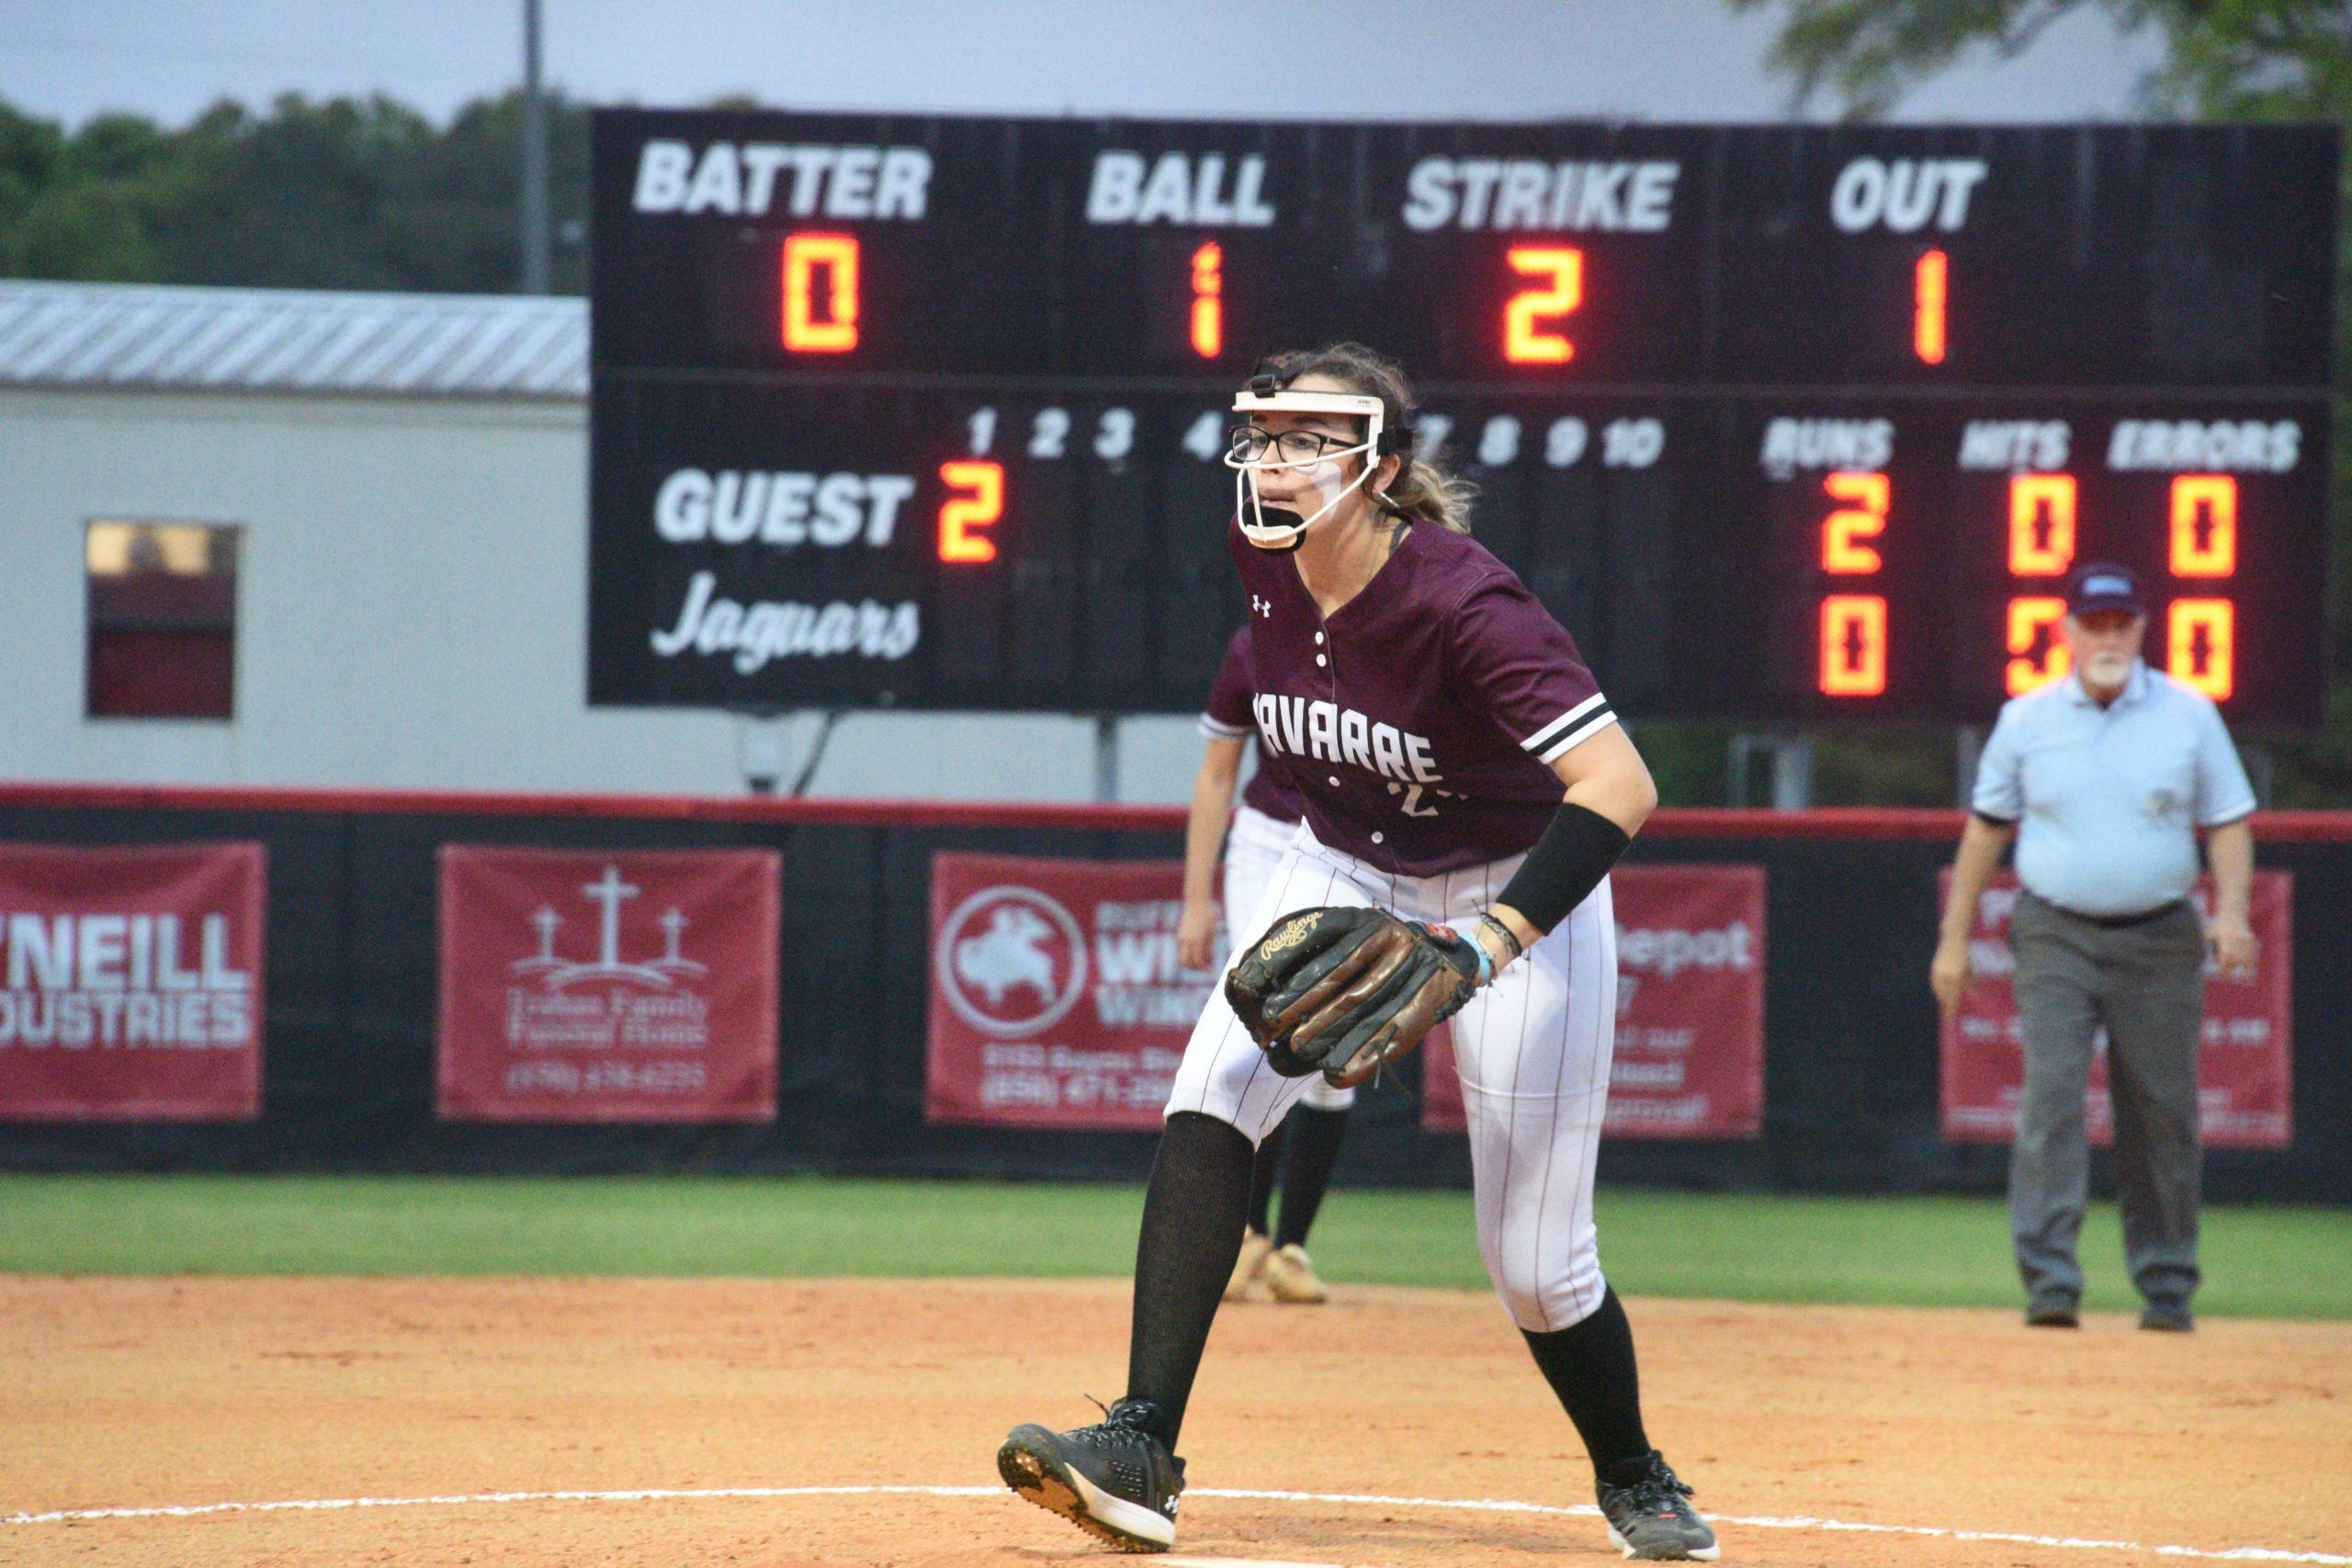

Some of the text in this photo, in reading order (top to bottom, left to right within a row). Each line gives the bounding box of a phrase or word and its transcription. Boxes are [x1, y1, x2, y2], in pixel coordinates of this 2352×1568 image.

[633, 140, 933, 220] BATTER
[1085, 151, 1275, 228] BALL
[1402, 155, 1679, 232] STRIKE
[1829, 157, 1988, 234] OUT
[780, 231, 861, 354] 0
[1189, 240, 1224, 359] 1
[1501, 242, 1586, 365] 2
[1914, 248, 1949, 366] 1
[969, 407, 998, 456] 1
[1028, 407, 1071, 459] 2
[1093, 407, 1136, 459] 3
[1182, 411, 1224, 462] 4
[1477, 415, 1521, 468] 8
[1544, 416, 1589, 468] 9
[1601, 417, 1666, 469] 10
[1760, 418, 1894, 469] RUNS
[1958, 420, 2071, 470] HITS
[2107, 420, 2301, 472] ERRORS
[653, 468, 916, 548] GUEST
[937, 459, 1005, 564] 2
[1820, 471, 2238, 579] 2 0 0
[650, 570, 921, 675] Jaguars
[1818, 593, 1887, 696] 0
[2165, 597, 2234, 701] 0
[1261, 911, 1323, 960] Rawlings
[1614, 919, 1753, 983] epot
